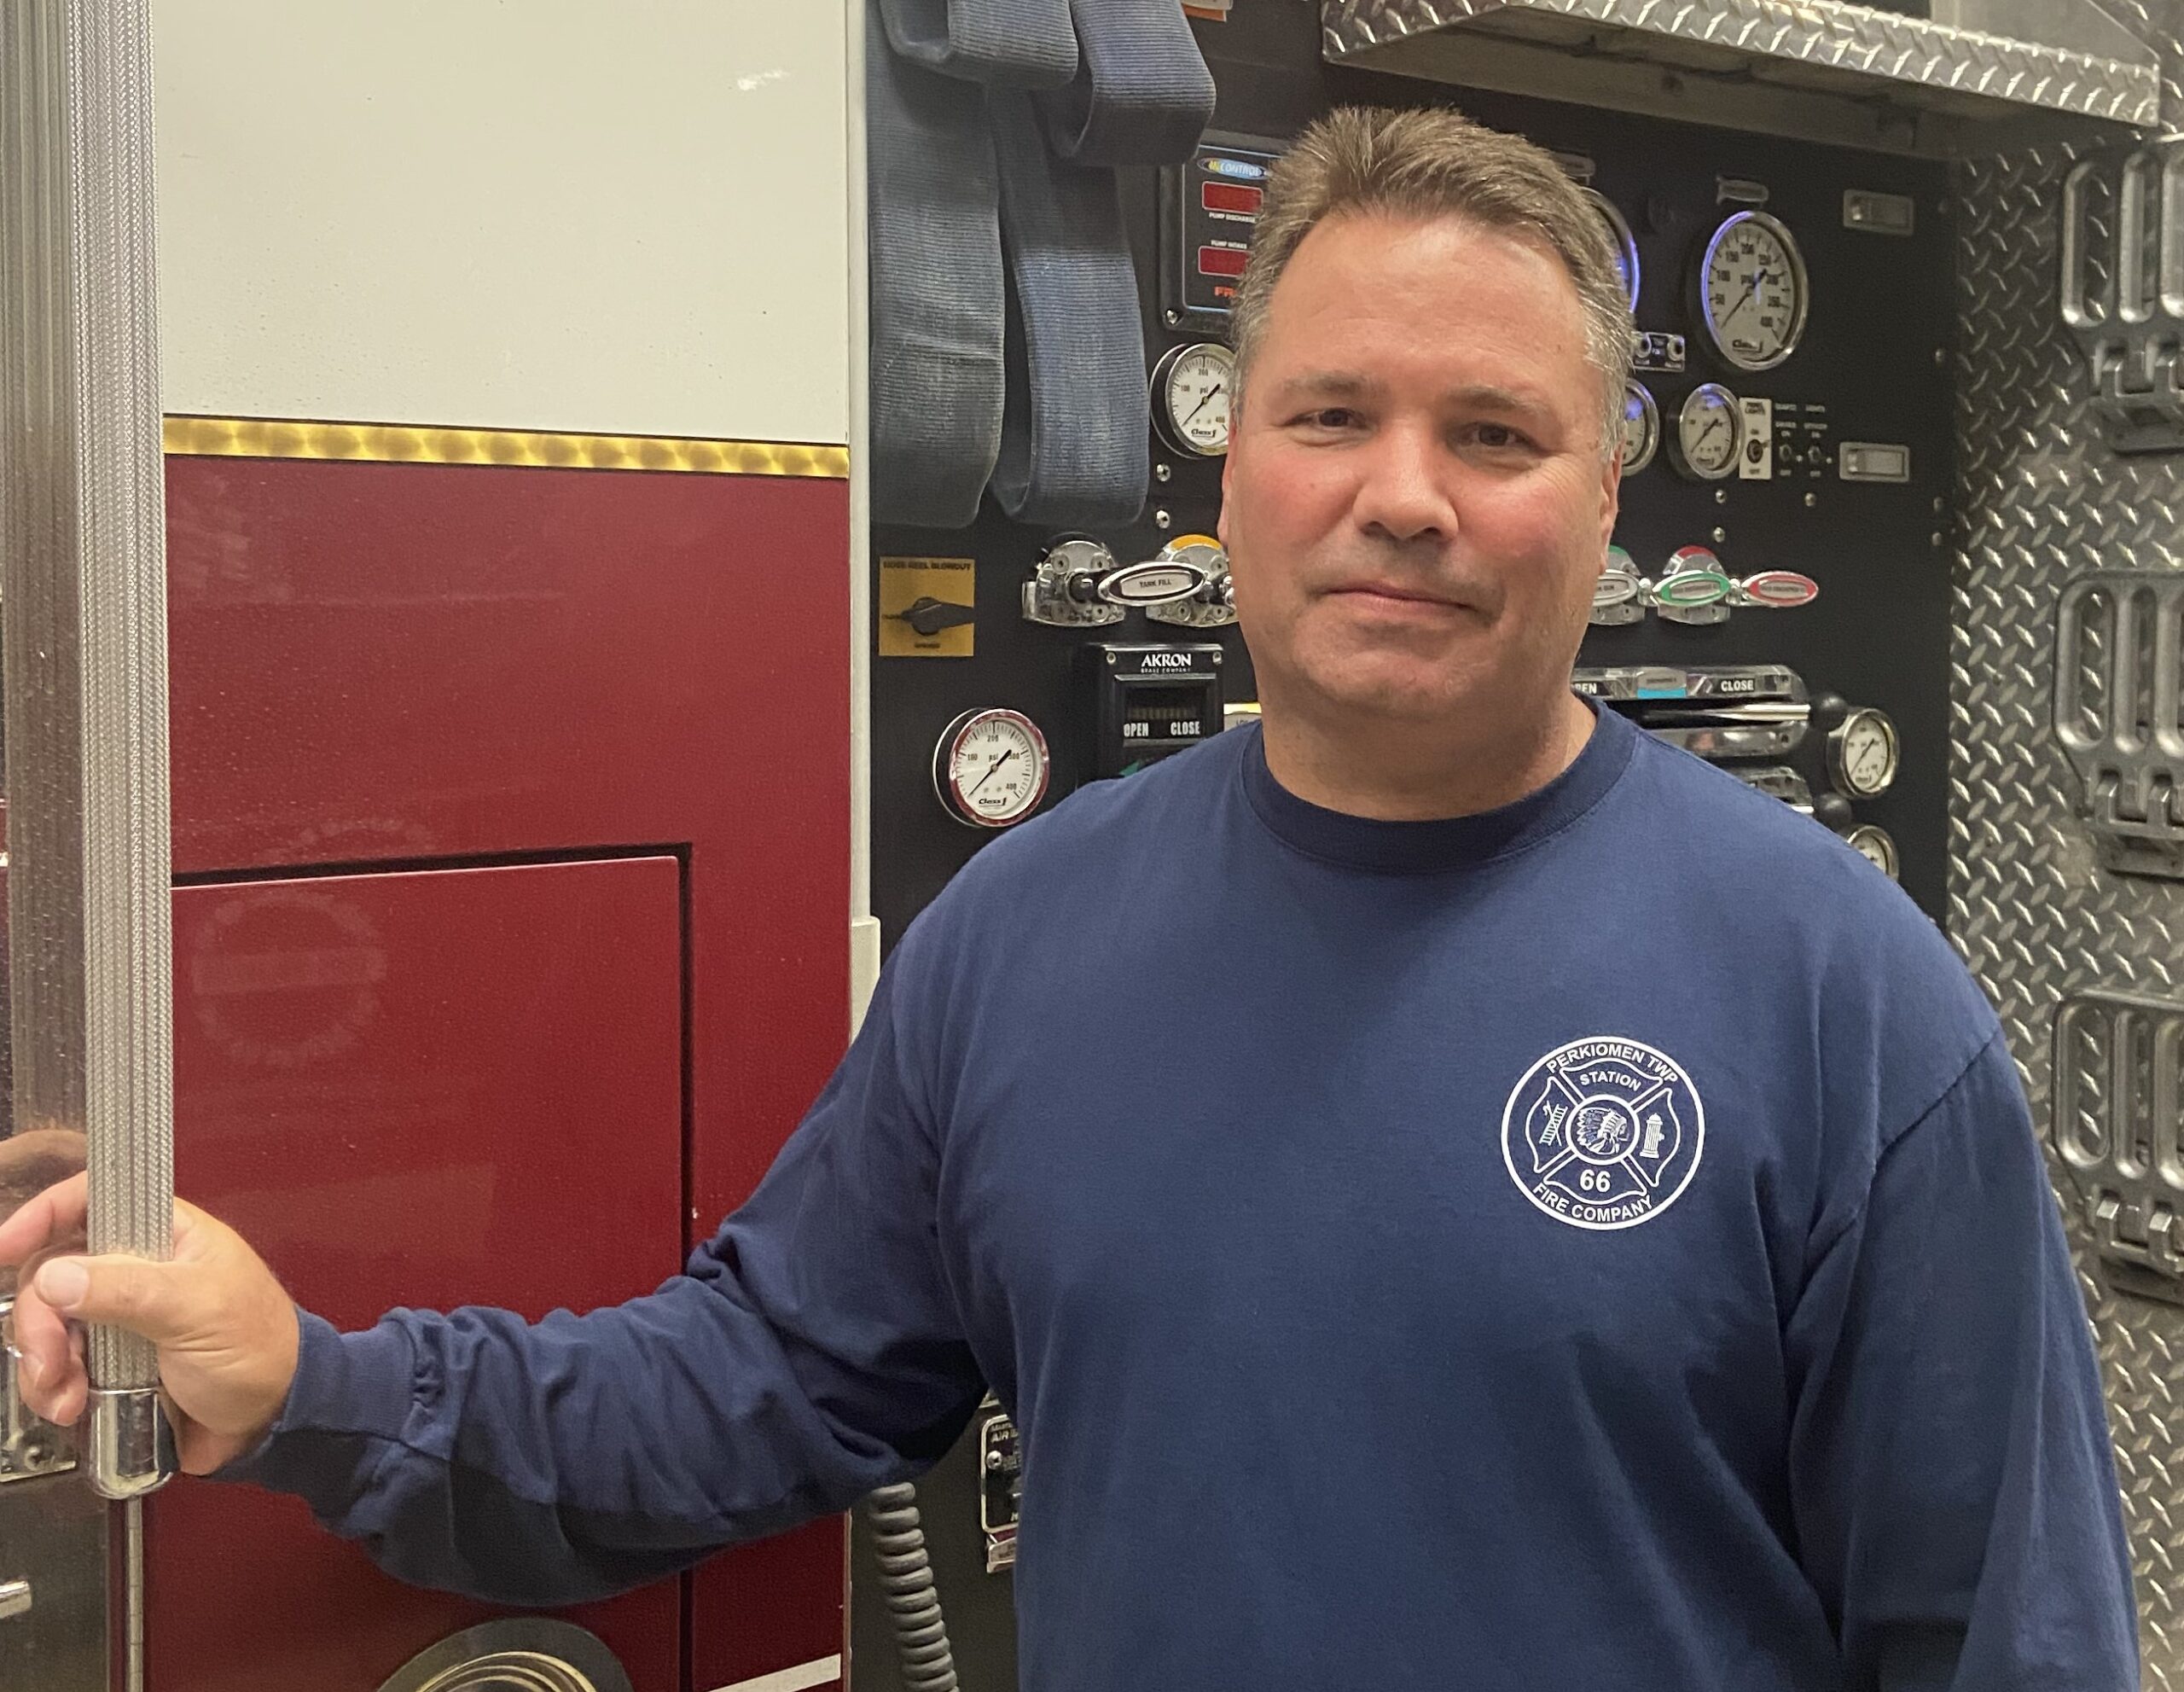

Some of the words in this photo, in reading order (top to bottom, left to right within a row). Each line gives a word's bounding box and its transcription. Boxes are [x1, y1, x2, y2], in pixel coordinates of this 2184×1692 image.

[1141, 653, 1192, 667] AKRON
[1571, 682, 1597, 694] PEN
[1720, 679, 1754, 692] CLOSE
[1123, 723, 1149, 737] OPEN
[1170, 721, 1200, 736] CLOSE
[989, 753, 999, 762] psi
[1545, 1044, 1645, 1074] PERKIOMEN
[1648, 1057, 1679, 1083] TWP
[1579, 1071, 1641, 1091] STATION
[1579, 1169, 1612, 1193] 66
[1532, 1182, 1570, 1213] FIRE
[1571, 1195, 1653, 1222] COMPANY
[990, 1431, 1010, 1444] AIR
